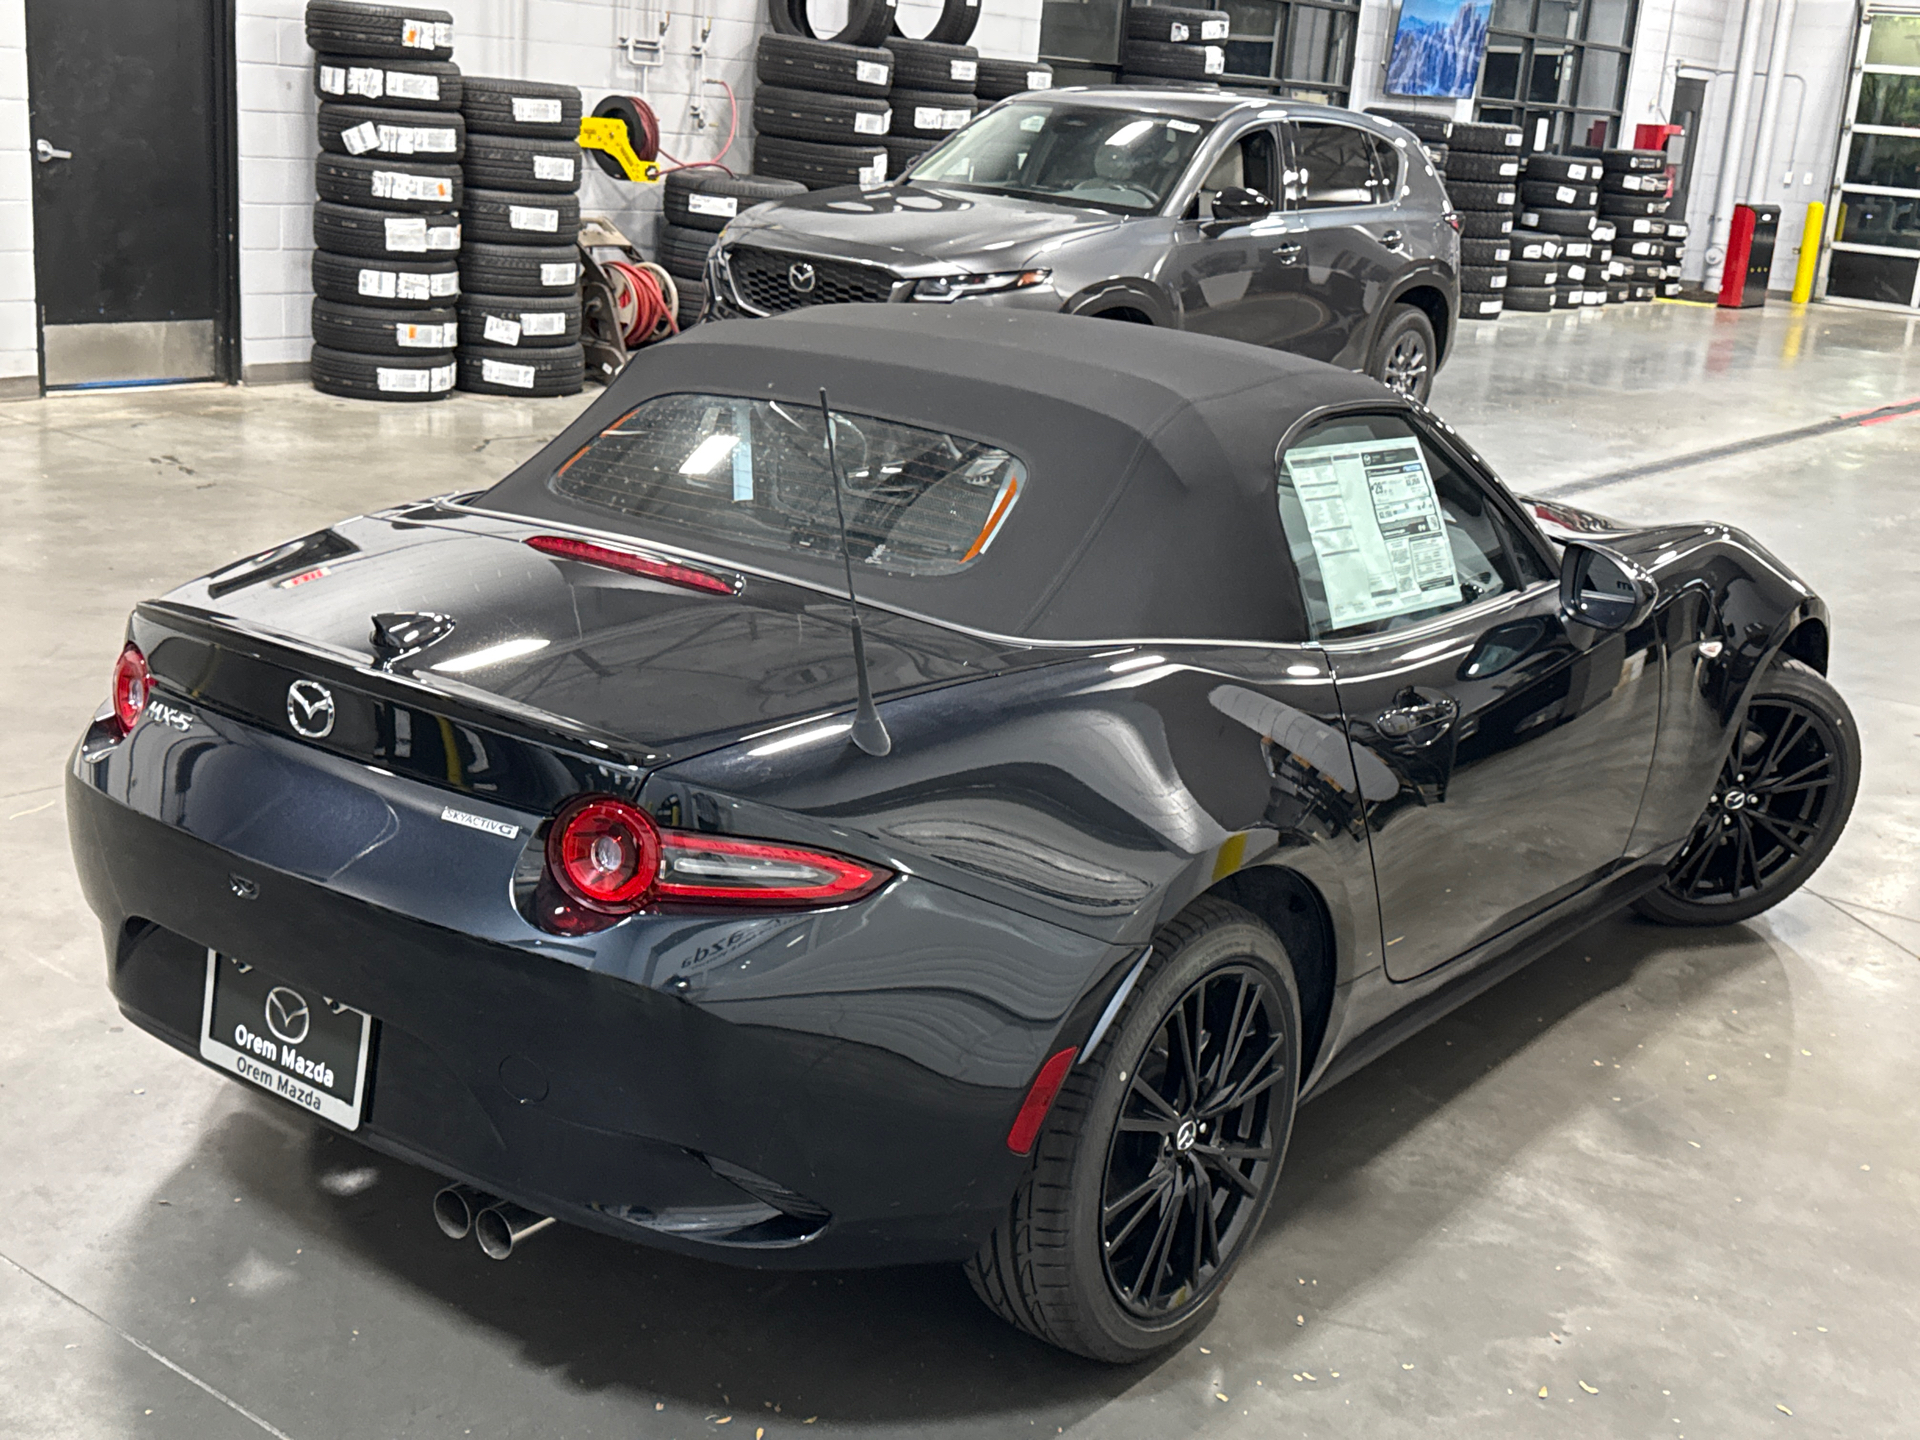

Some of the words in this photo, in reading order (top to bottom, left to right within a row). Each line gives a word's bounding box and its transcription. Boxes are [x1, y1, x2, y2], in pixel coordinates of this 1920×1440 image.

[145, 700, 193, 732] MX-5
[234, 1023, 277, 1062] Orem
[280, 1044, 334, 1088] Mazda
[236, 1056, 273, 1088] Orem
[276, 1074, 322, 1111] Mazda
